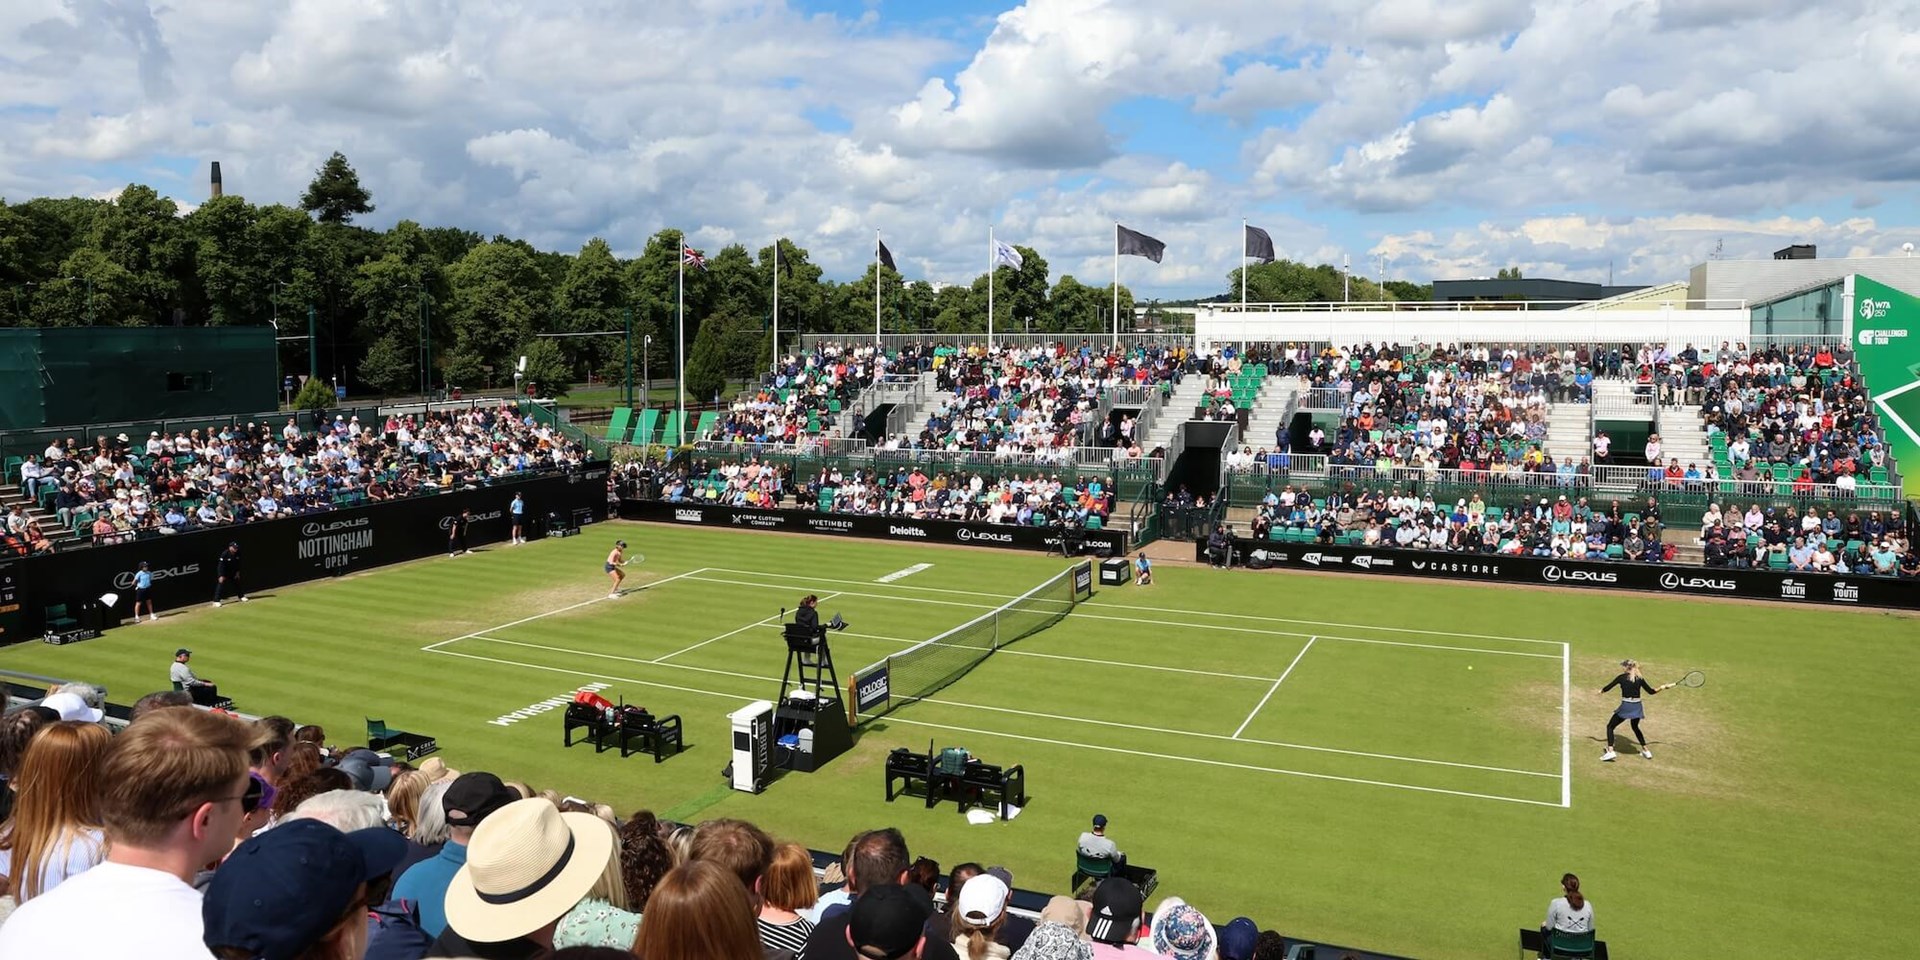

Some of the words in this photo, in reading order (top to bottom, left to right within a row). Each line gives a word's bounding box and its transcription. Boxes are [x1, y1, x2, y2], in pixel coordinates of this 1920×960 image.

[1875, 301, 1891, 309] WTA
[1874, 309, 1887, 317] 250
[1874, 329, 1908, 337] CHALLENGER
[1874, 337, 1889, 345] TOUR
[466, 511, 501, 523] EXUS
[675, 508, 703, 516] HOLOGIC
[321, 517, 369, 531] LEXUS
[808, 519, 853, 528] NYETIMBER
[889, 525, 927, 537] Deloitte.
[971, 531, 1013, 542] LEXUS
[298, 529, 373, 559] NOTTINGHAM
[325, 554, 349, 568] OPEN
[1306, 554, 1321, 563] LTA
[1356, 557, 1372, 566] LTA
[151, 563, 200, 581] EXUS
[1430, 562, 1499, 574] CASTORE
[1562, 570, 1618, 582] LEXUS
[1680, 577, 1737, 589] LEXUS
[1781, 585, 1806, 595] YOUTH
[1833, 588, 1859, 598] YOUTH
[860, 676, 887, 698] HOLOGIC
[420, 740, 436, 750] CREW
[759, 733, 768, 773] BRITA
